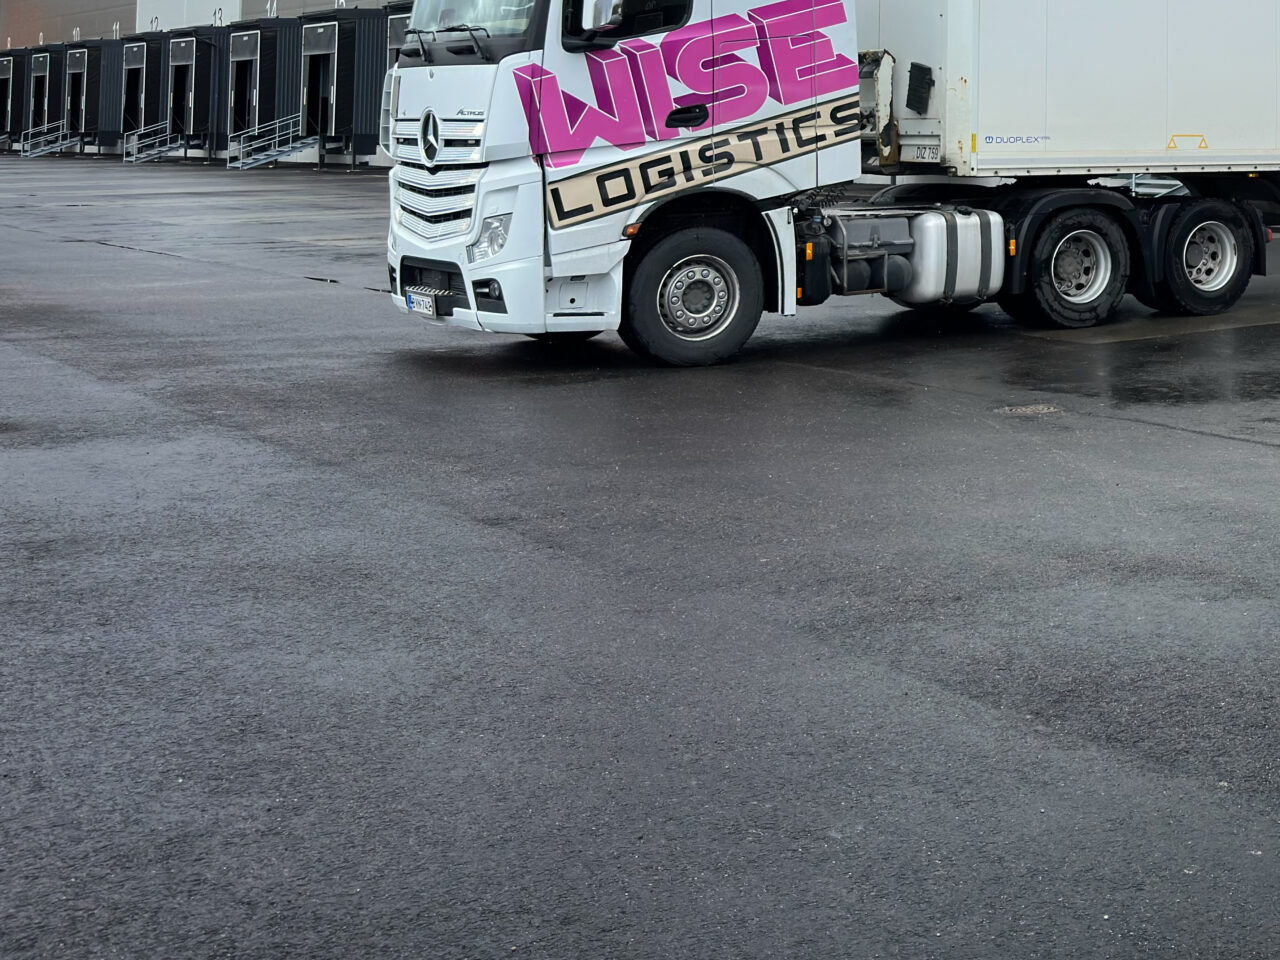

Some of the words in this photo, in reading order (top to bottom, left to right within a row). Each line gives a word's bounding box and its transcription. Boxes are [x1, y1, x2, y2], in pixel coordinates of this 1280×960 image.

[266, 0, 278, 17] 14
[995, 136, 1039, 144] DUOPLEX
[550, 100, 860, 221] LOGISTICS
